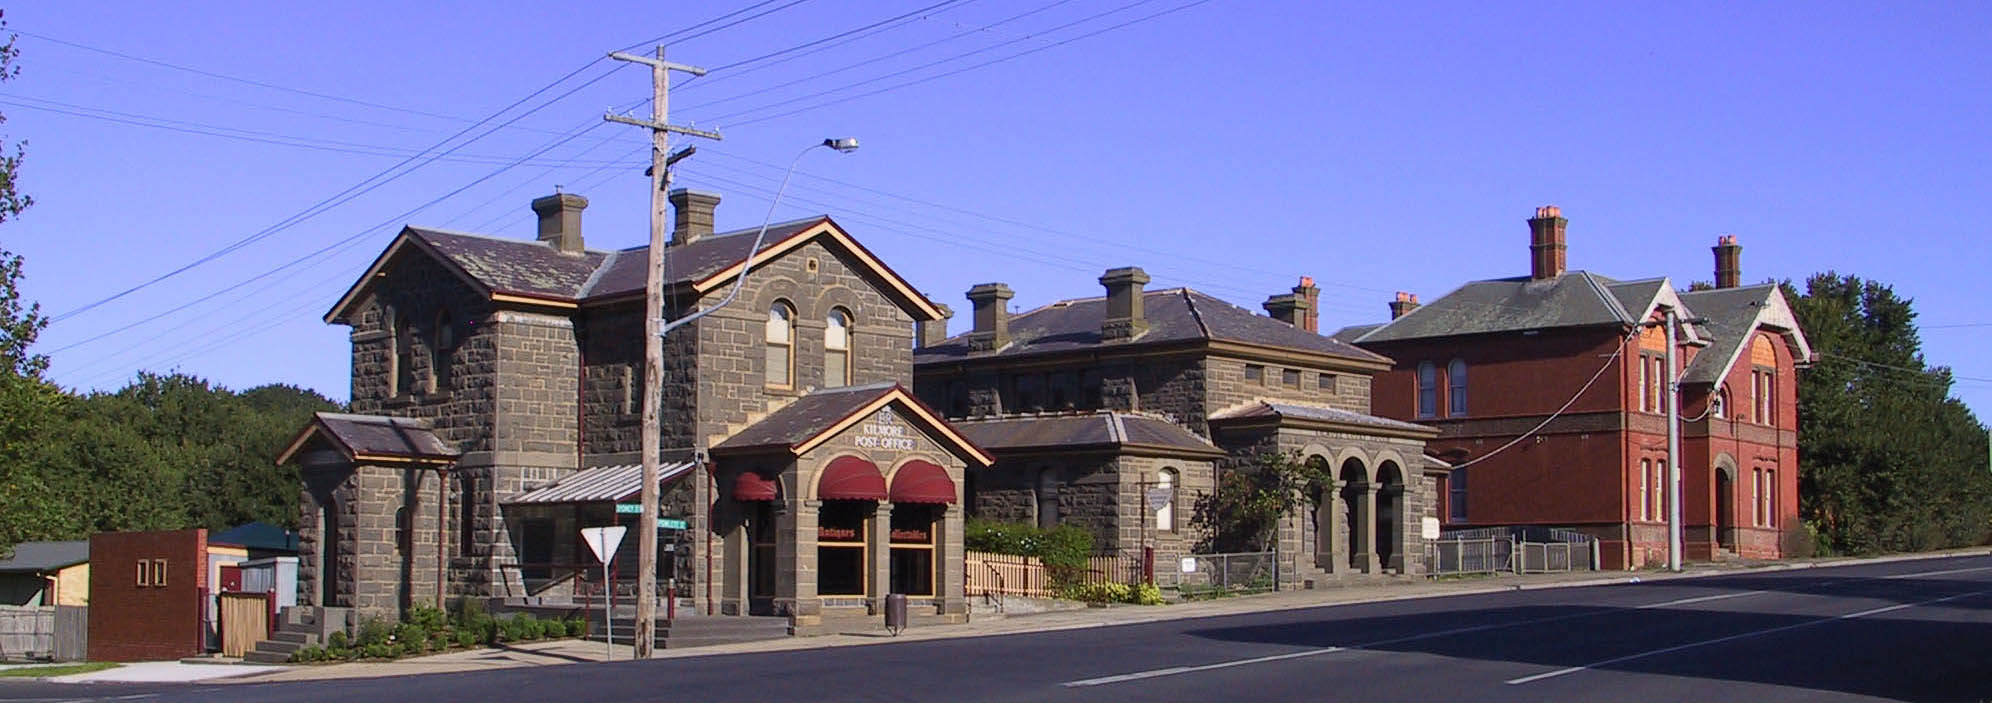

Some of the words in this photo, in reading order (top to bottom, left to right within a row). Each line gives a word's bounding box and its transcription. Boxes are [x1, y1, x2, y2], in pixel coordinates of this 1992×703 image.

[863, 424, 905, 437] KILMORE
[855, 436, 880, 448] POST
[881, 438, 914, 450] OFFICE
